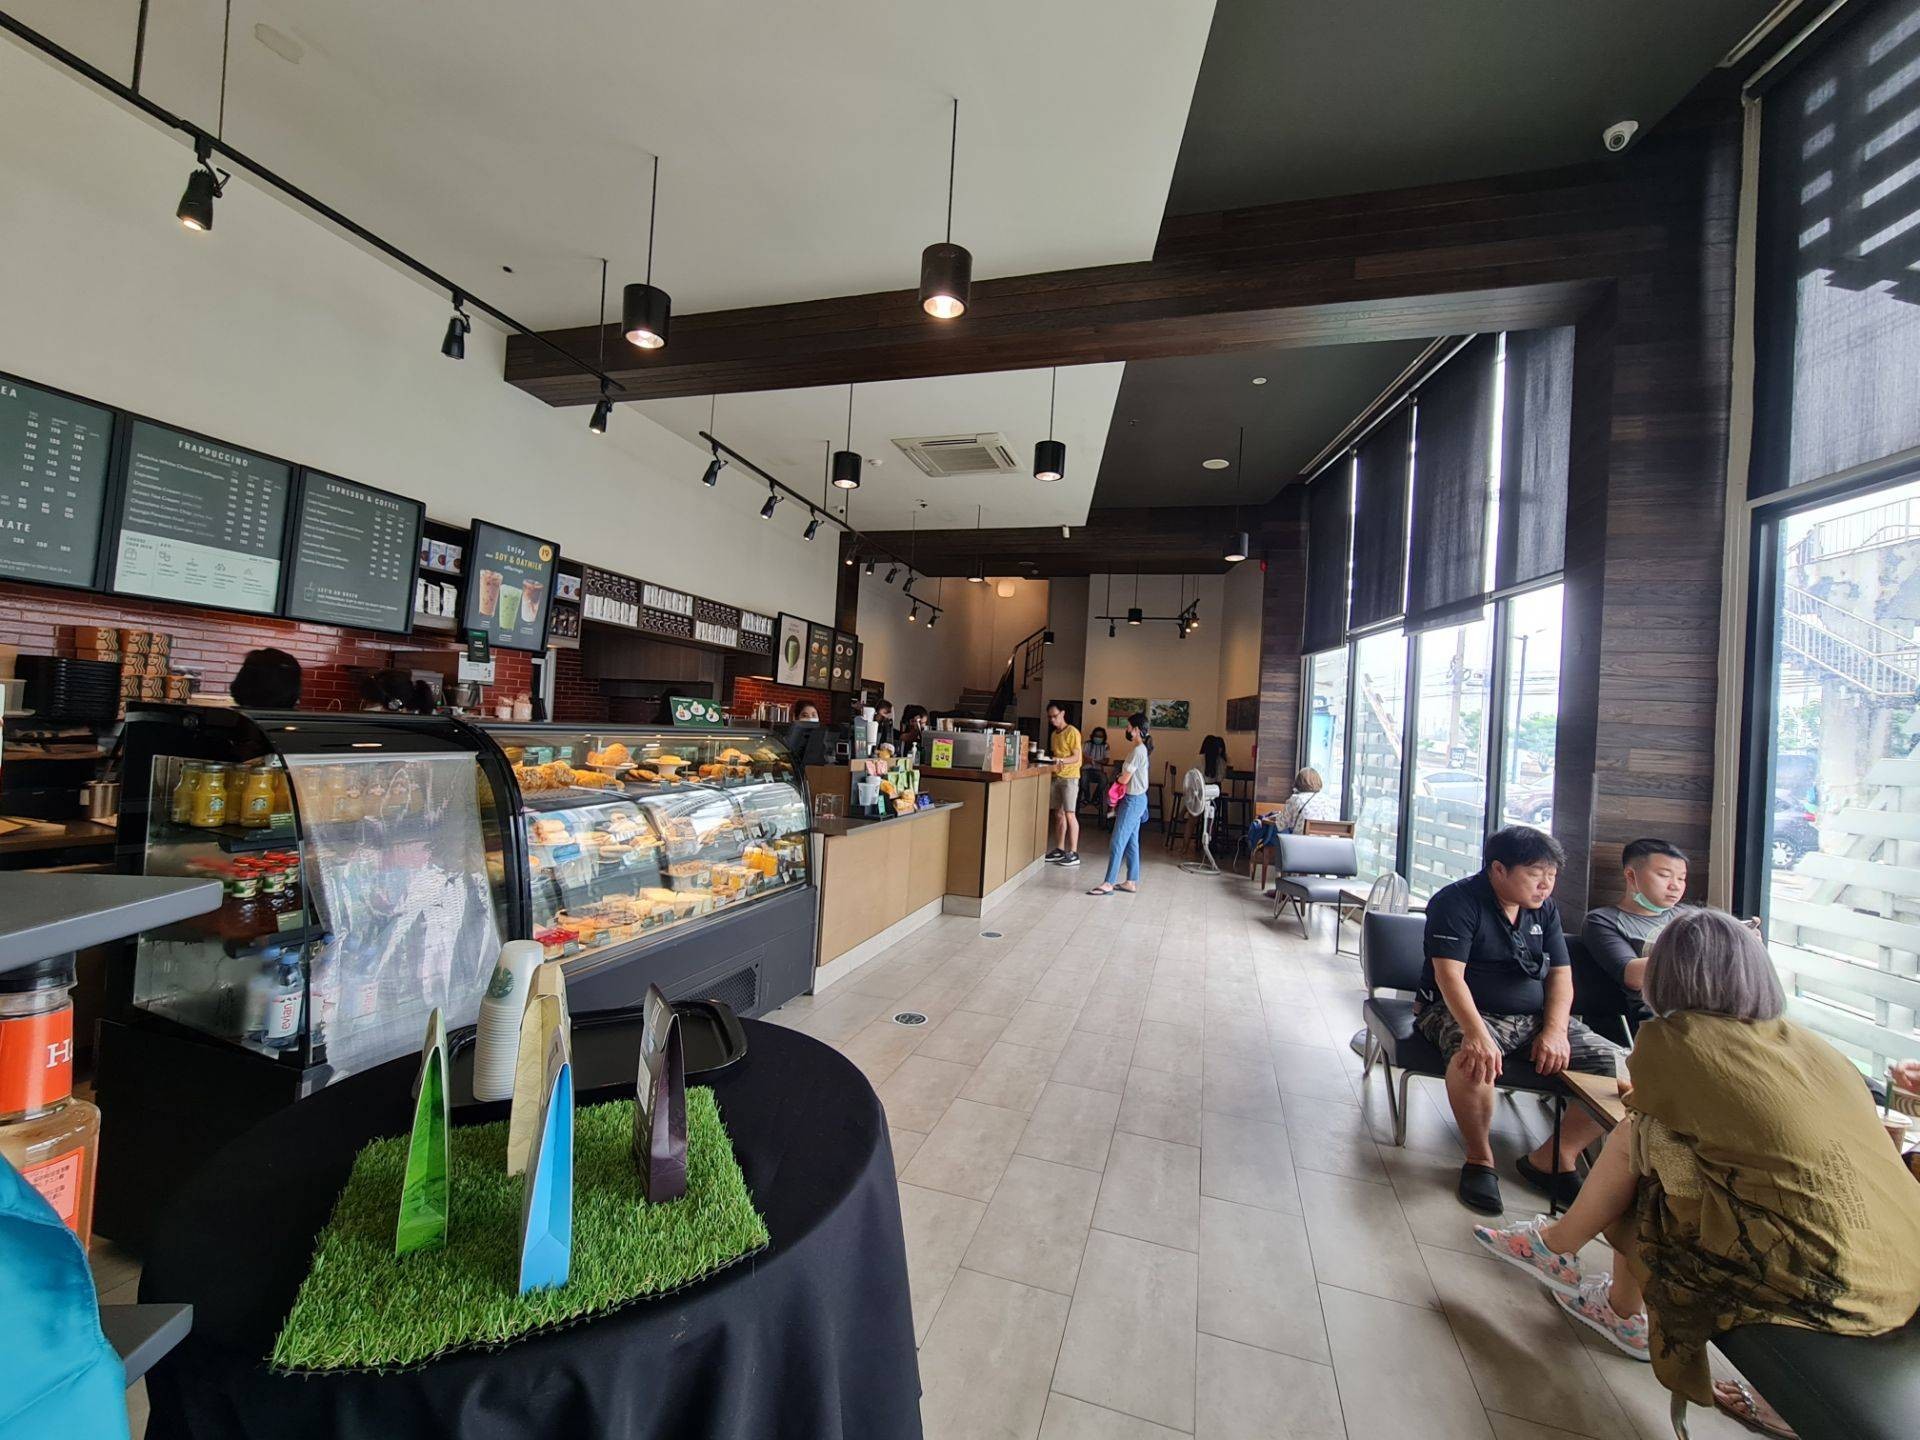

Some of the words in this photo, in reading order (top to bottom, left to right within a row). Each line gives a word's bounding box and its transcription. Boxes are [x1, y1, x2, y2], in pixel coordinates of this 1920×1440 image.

[178, 440, 248, 467] FRAPPUCCINO
[326, 483, 364, 501] ESPRESSO
[374, 497, 400, 511] COFFEE
[495, 551, 507, 561] SOY
[516, 556, 542, 571] OATMILK
[507, 545, 525, 556] Enjoy
[282, 1002, 294, 1030] evian
[46, 1038, 73, 1068] H
